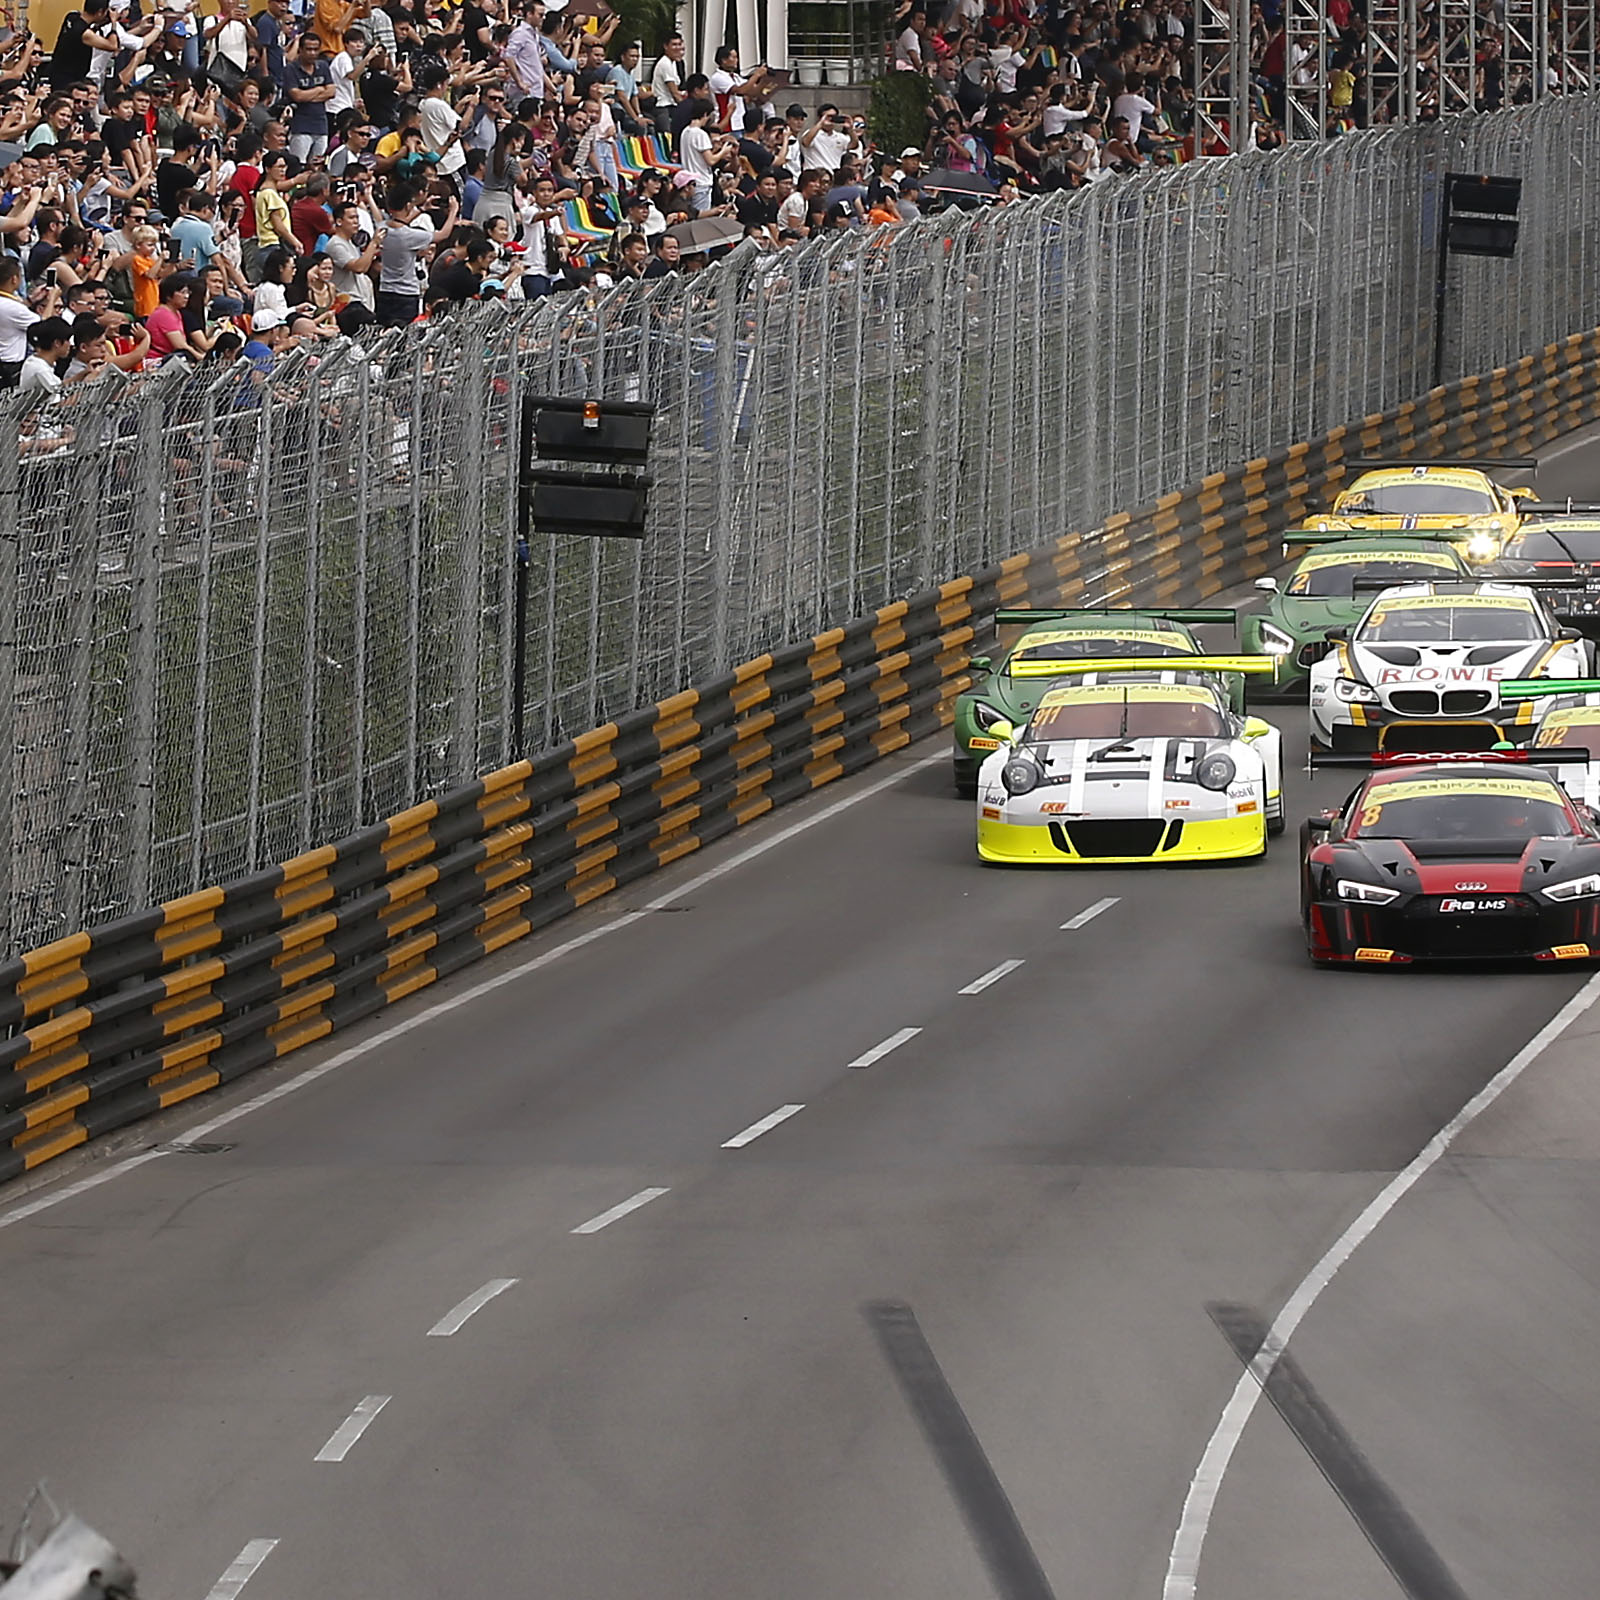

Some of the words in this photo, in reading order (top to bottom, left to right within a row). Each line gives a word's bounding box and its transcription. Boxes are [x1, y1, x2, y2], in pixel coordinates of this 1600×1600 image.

[1290, 573, 1310, 590] 2
[1380, 667, 1507, 683] ROWE
[1032, 706, 1062, 728] 911
[1536, 727, 1568, 748] 912
[1360, 805, 1382, 827] 8
[1478, 900, 1506, 910] LMS
